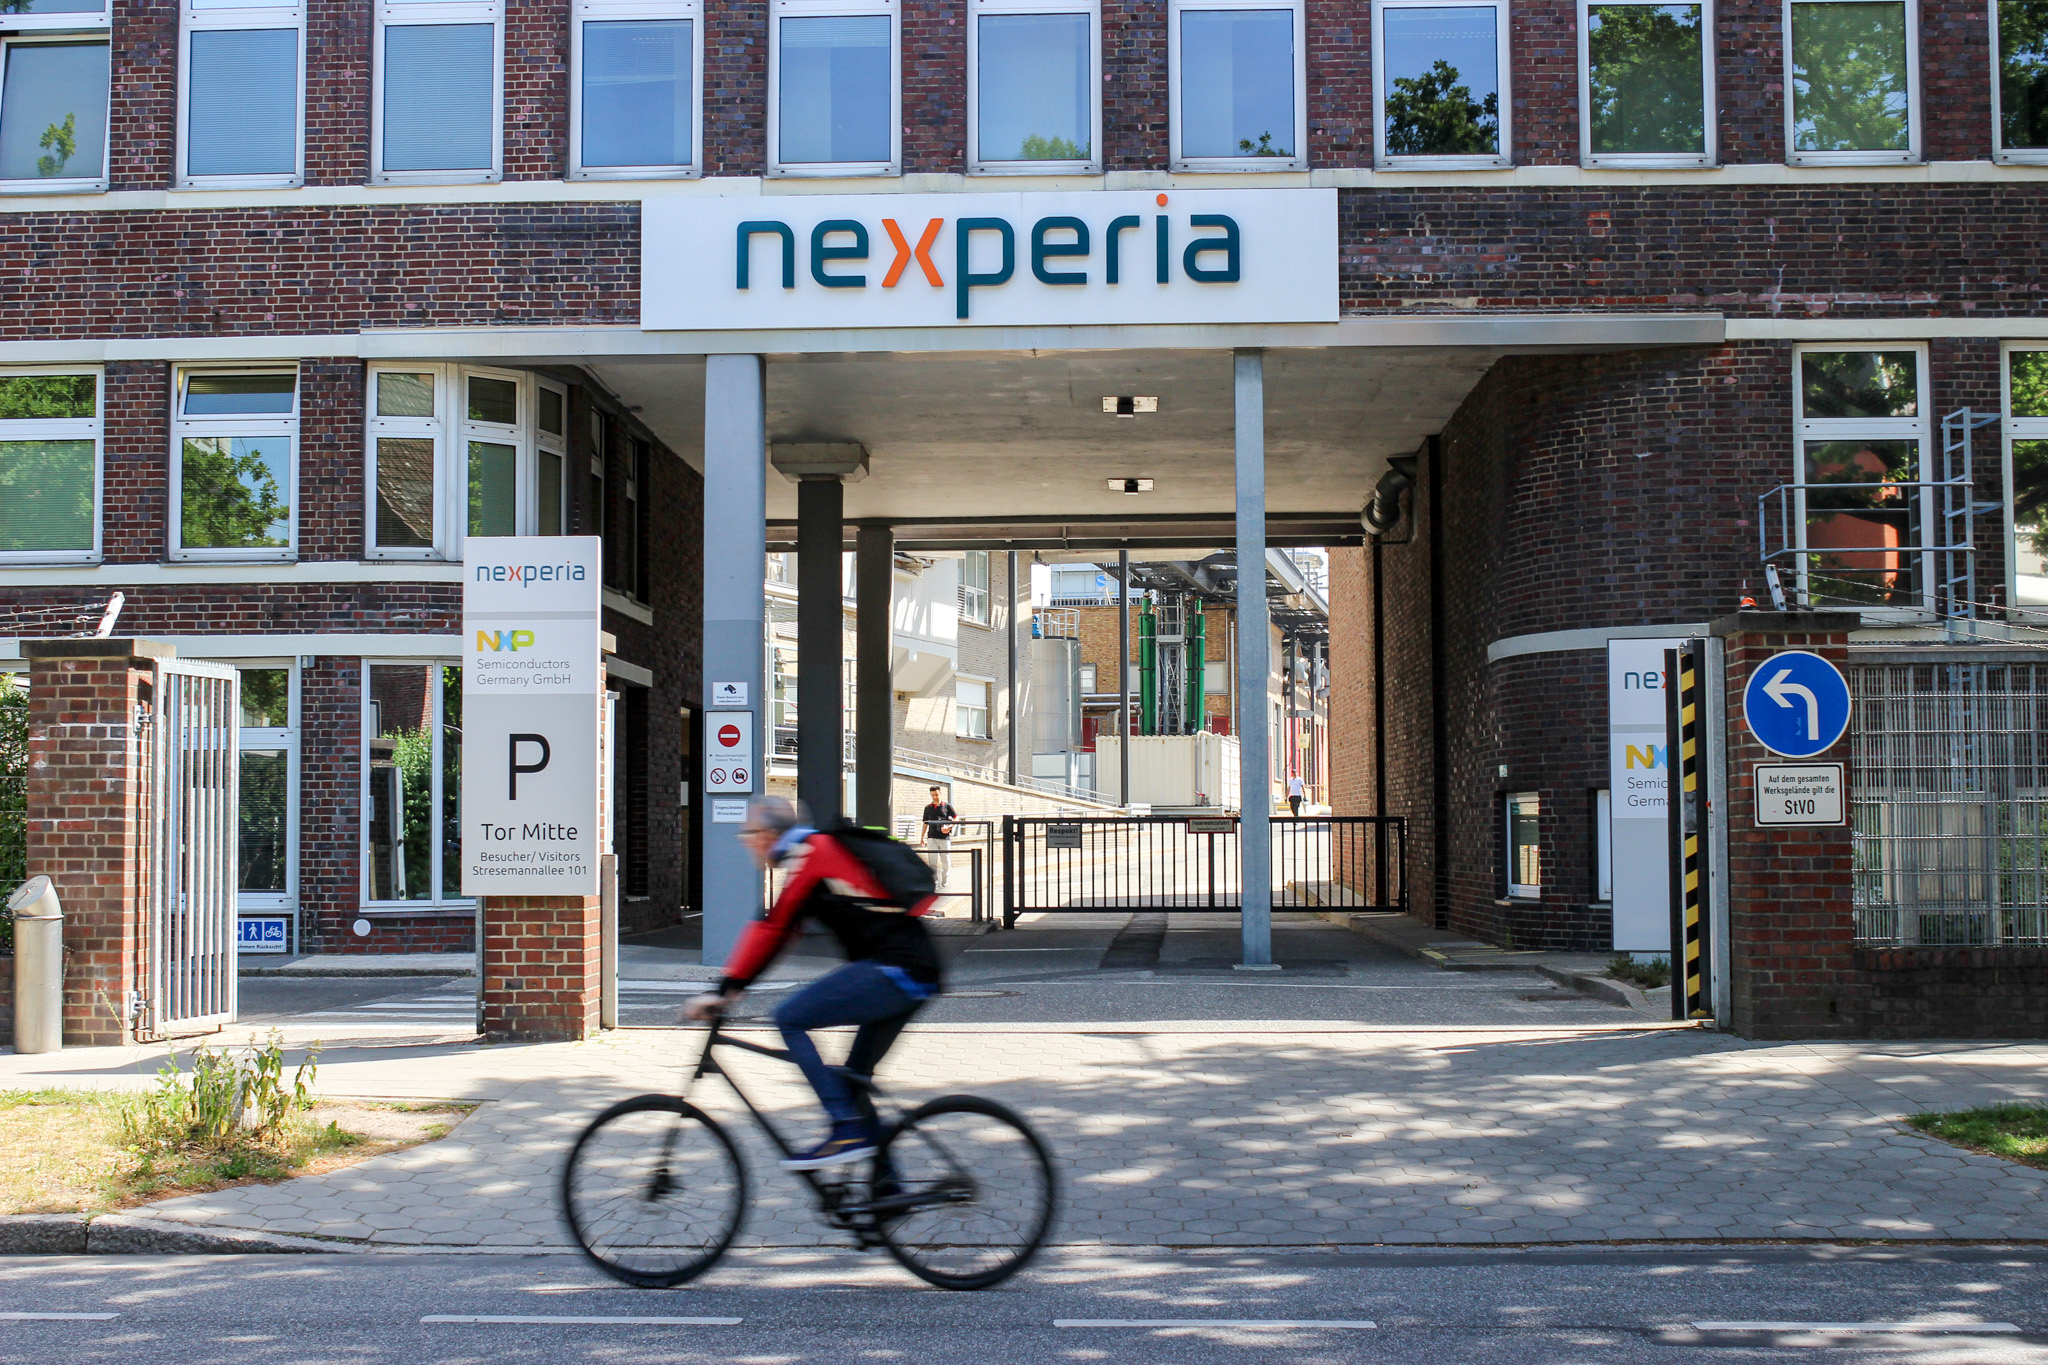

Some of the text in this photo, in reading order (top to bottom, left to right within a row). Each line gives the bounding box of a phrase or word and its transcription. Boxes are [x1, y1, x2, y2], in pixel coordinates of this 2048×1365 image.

[736, 193, 1241, 320] nexperia
[476, 560, 586, 589] nexperia
[476, 630, 535, 652] NXP
[477, 658, 570, 670] Semiconductors
[476, 673, 571, 688] Germany GmbH
[508, 733, 551, 801] P
[1768, 775, 1830, 784] Auf dem gesamten
[1763, 785, 1835, 796] Werksgelände gilt die
[1627, 794, 1669, 807] Germ
[1784, 799, 1815, 815] StVO
[480, 822, 578, 841] Tor Mitte
[1049, 826, 1079, 835] Respekt!
[480, 851, 581, 864] Besucher/ Visitors
[472, 865, 588, 876] Stresemannallee 101
